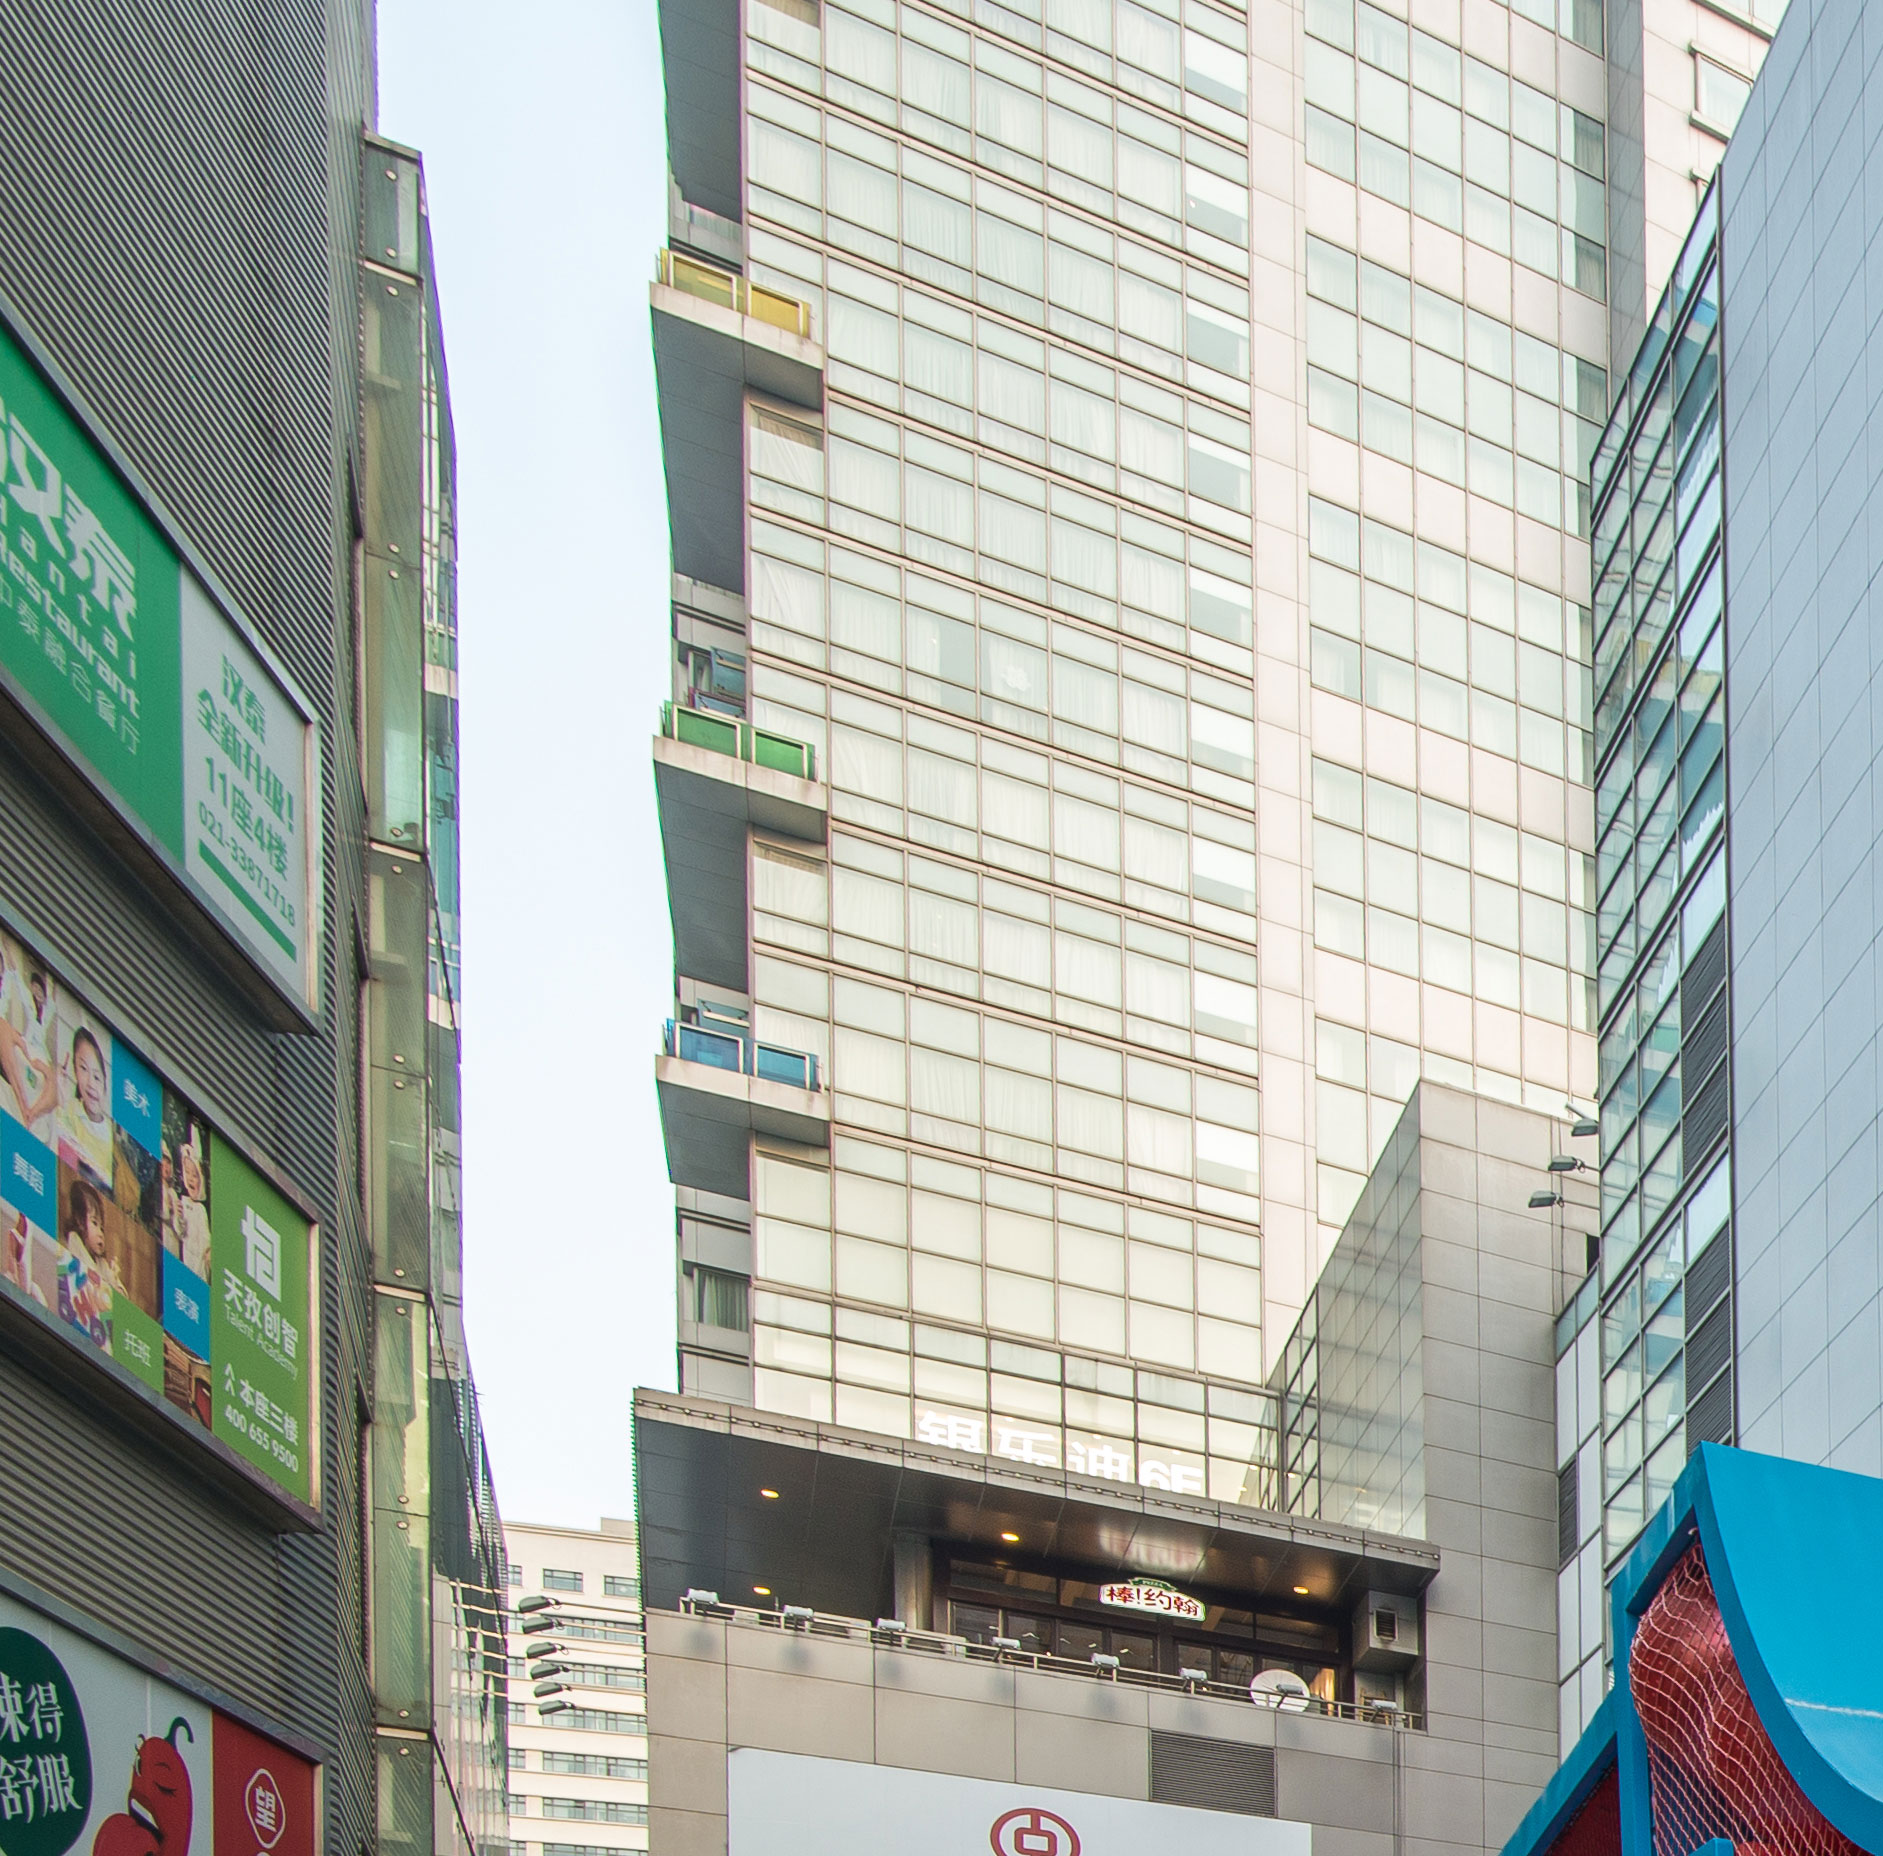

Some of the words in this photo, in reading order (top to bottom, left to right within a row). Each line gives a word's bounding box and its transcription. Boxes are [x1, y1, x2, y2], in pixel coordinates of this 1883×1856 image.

[0, 493, 137, 680] antai
[0, 531, 140, 719] estaurant
[222, 653, 266, 745] 汉泰
[205, 756, 288, 882] 11座4楼
[224, 1403, 248, 1434] 400
[248, 1421, 271, 1452] 655
